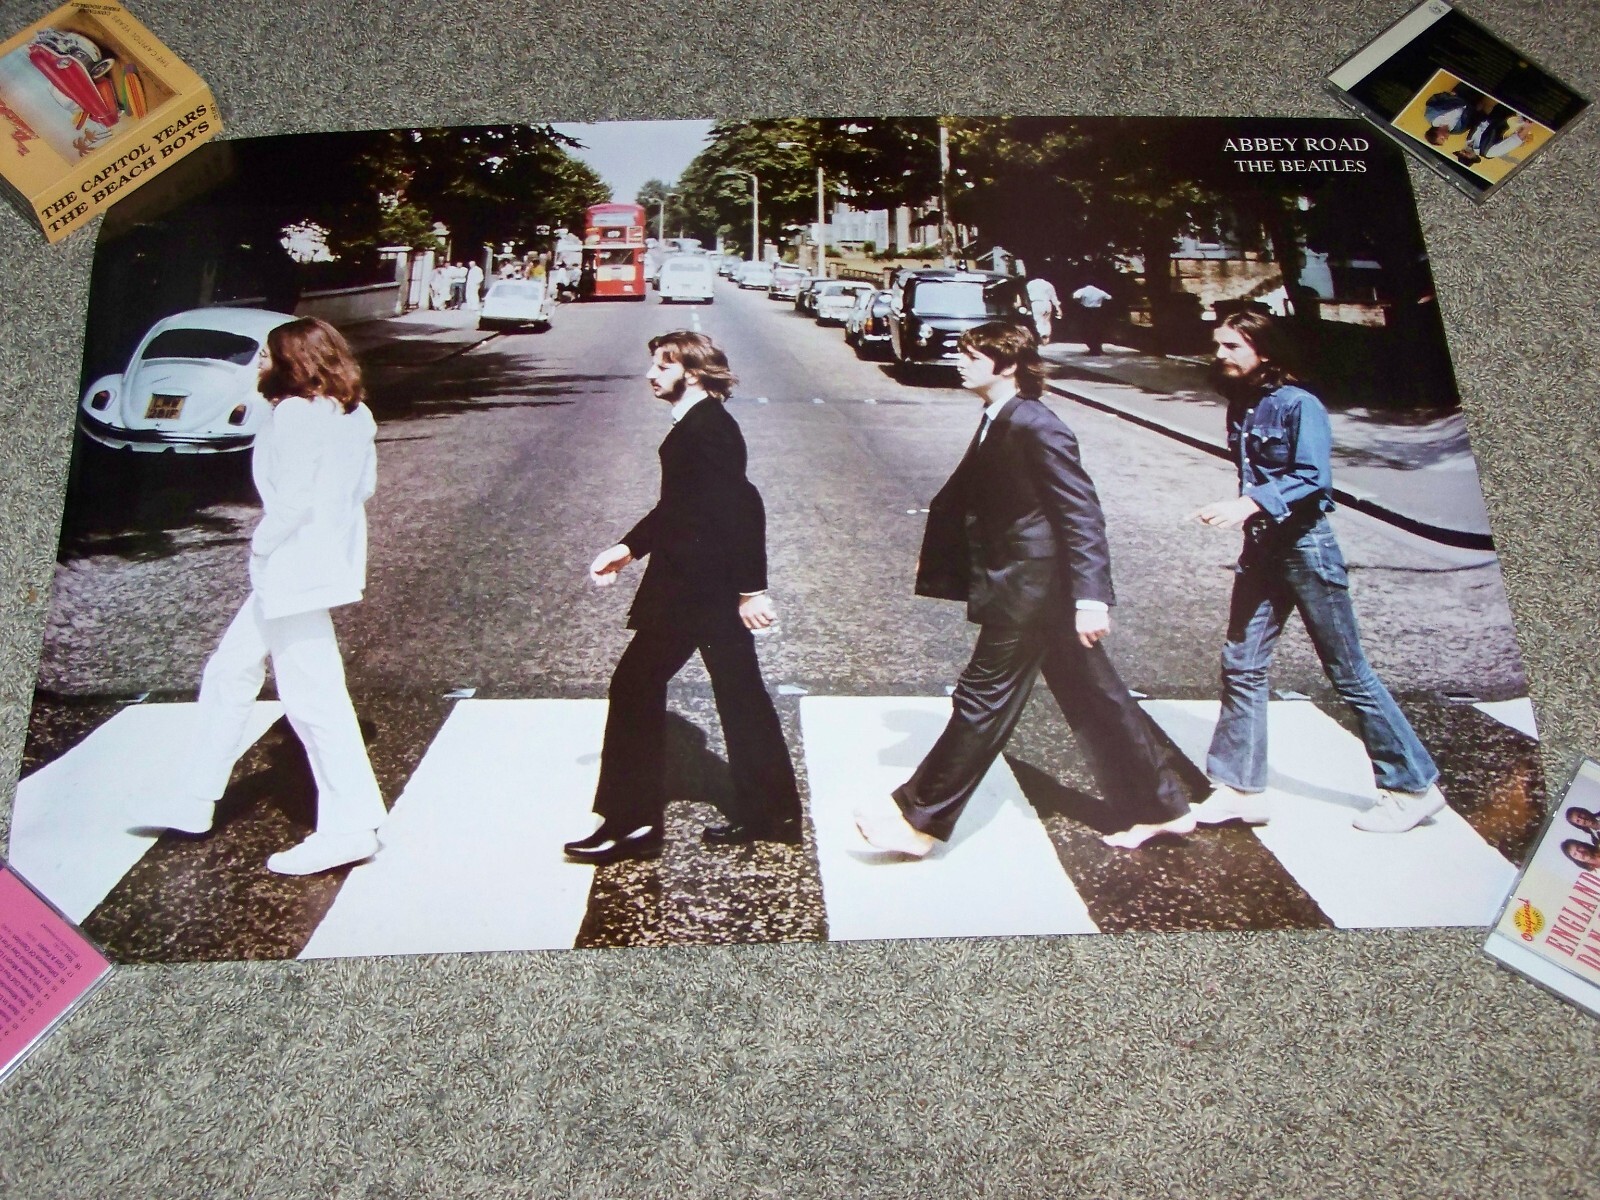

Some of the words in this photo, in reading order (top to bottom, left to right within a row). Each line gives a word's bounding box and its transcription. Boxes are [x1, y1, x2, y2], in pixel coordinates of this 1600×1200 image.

[131, 32, 158, 57] CAPITOL
[1223, 138, 1298, 152] ABBEY
[1305, 137, 1369, 152] ROAD
[41, 191, 78, 219] THE
[81, 144, 151, 193] CAPITOL
[153, 104, 207, 143] YEARS
[1234, 160, 1275, 173] THE
[1280, 159, 1367, 173] BEATLES
[48, 202, 89, 233] THE
[94, 158, 156, 204] BEACH
[162, 121, 210, 159] BOYS
[1518, 897, 1534, 942] Original
[1545, 871, 1600, 957] ENGLAND
[11, 933, 30, 950] Opinion
[34, 954, 58, 976] Difference
